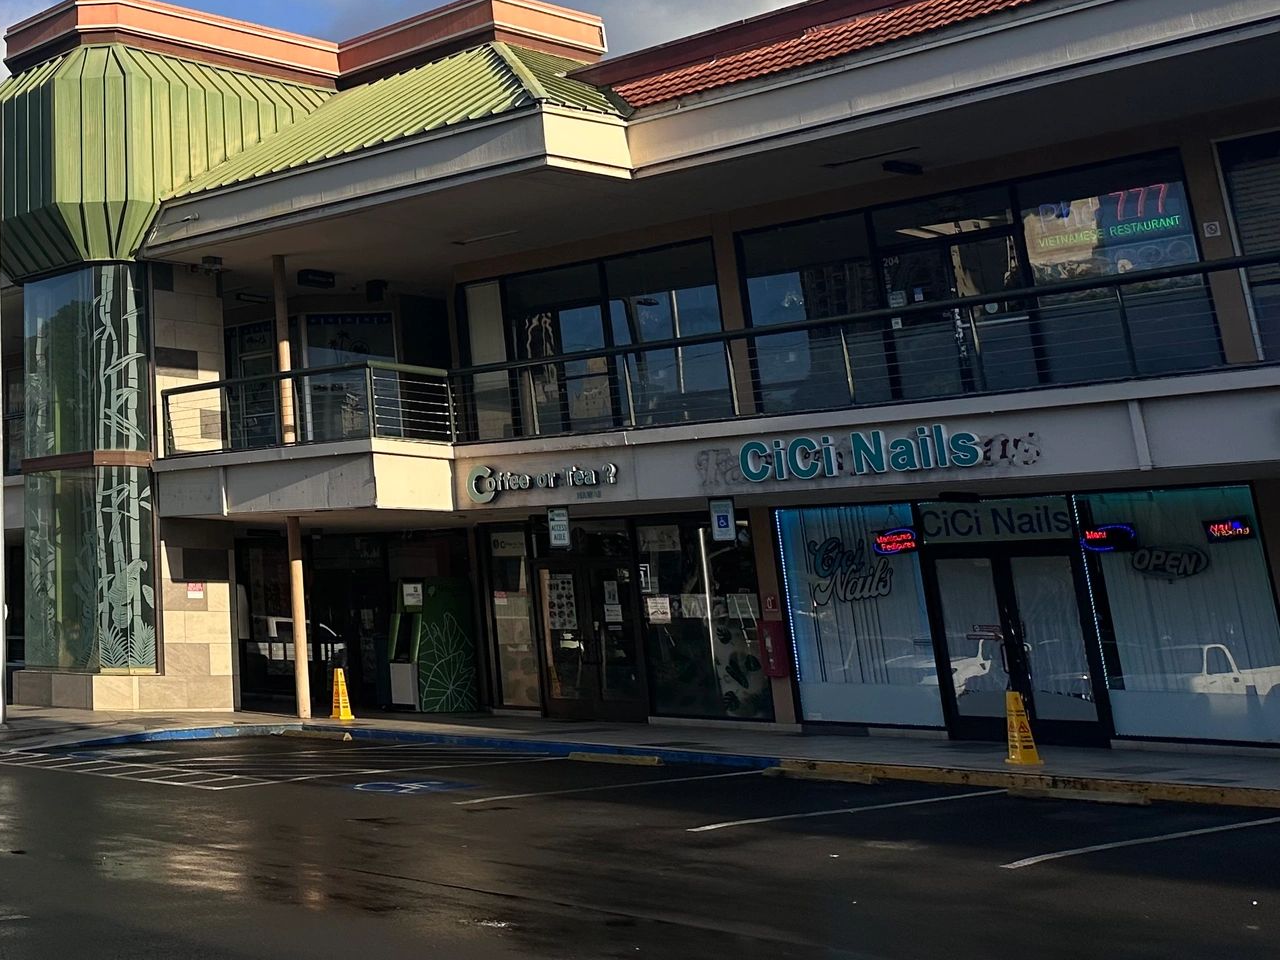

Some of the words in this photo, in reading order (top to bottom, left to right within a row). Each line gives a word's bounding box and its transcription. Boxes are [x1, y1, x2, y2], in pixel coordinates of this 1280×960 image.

[1107, 183, 1168, 221] 777
[1038, 228, 1104, 248] VIETNAMESE
[1109, 214, 1181, 237] RESTAURANT
[882, 255, 899, 267] 204
[738, 435, 838, 482] CiCi
[849, 423, 983, 476] Nails
[466, 464, 532, 504] Coffee
[536, 472, 557, 488] or
[562, 465, 598, 487] Tea
[921, 508, 983, 538] CiCi
[990, 505, 1071, 536] Nails
[1132, 548, 1198, 576] OPEN
[813, 557, 893, 606] Nails
